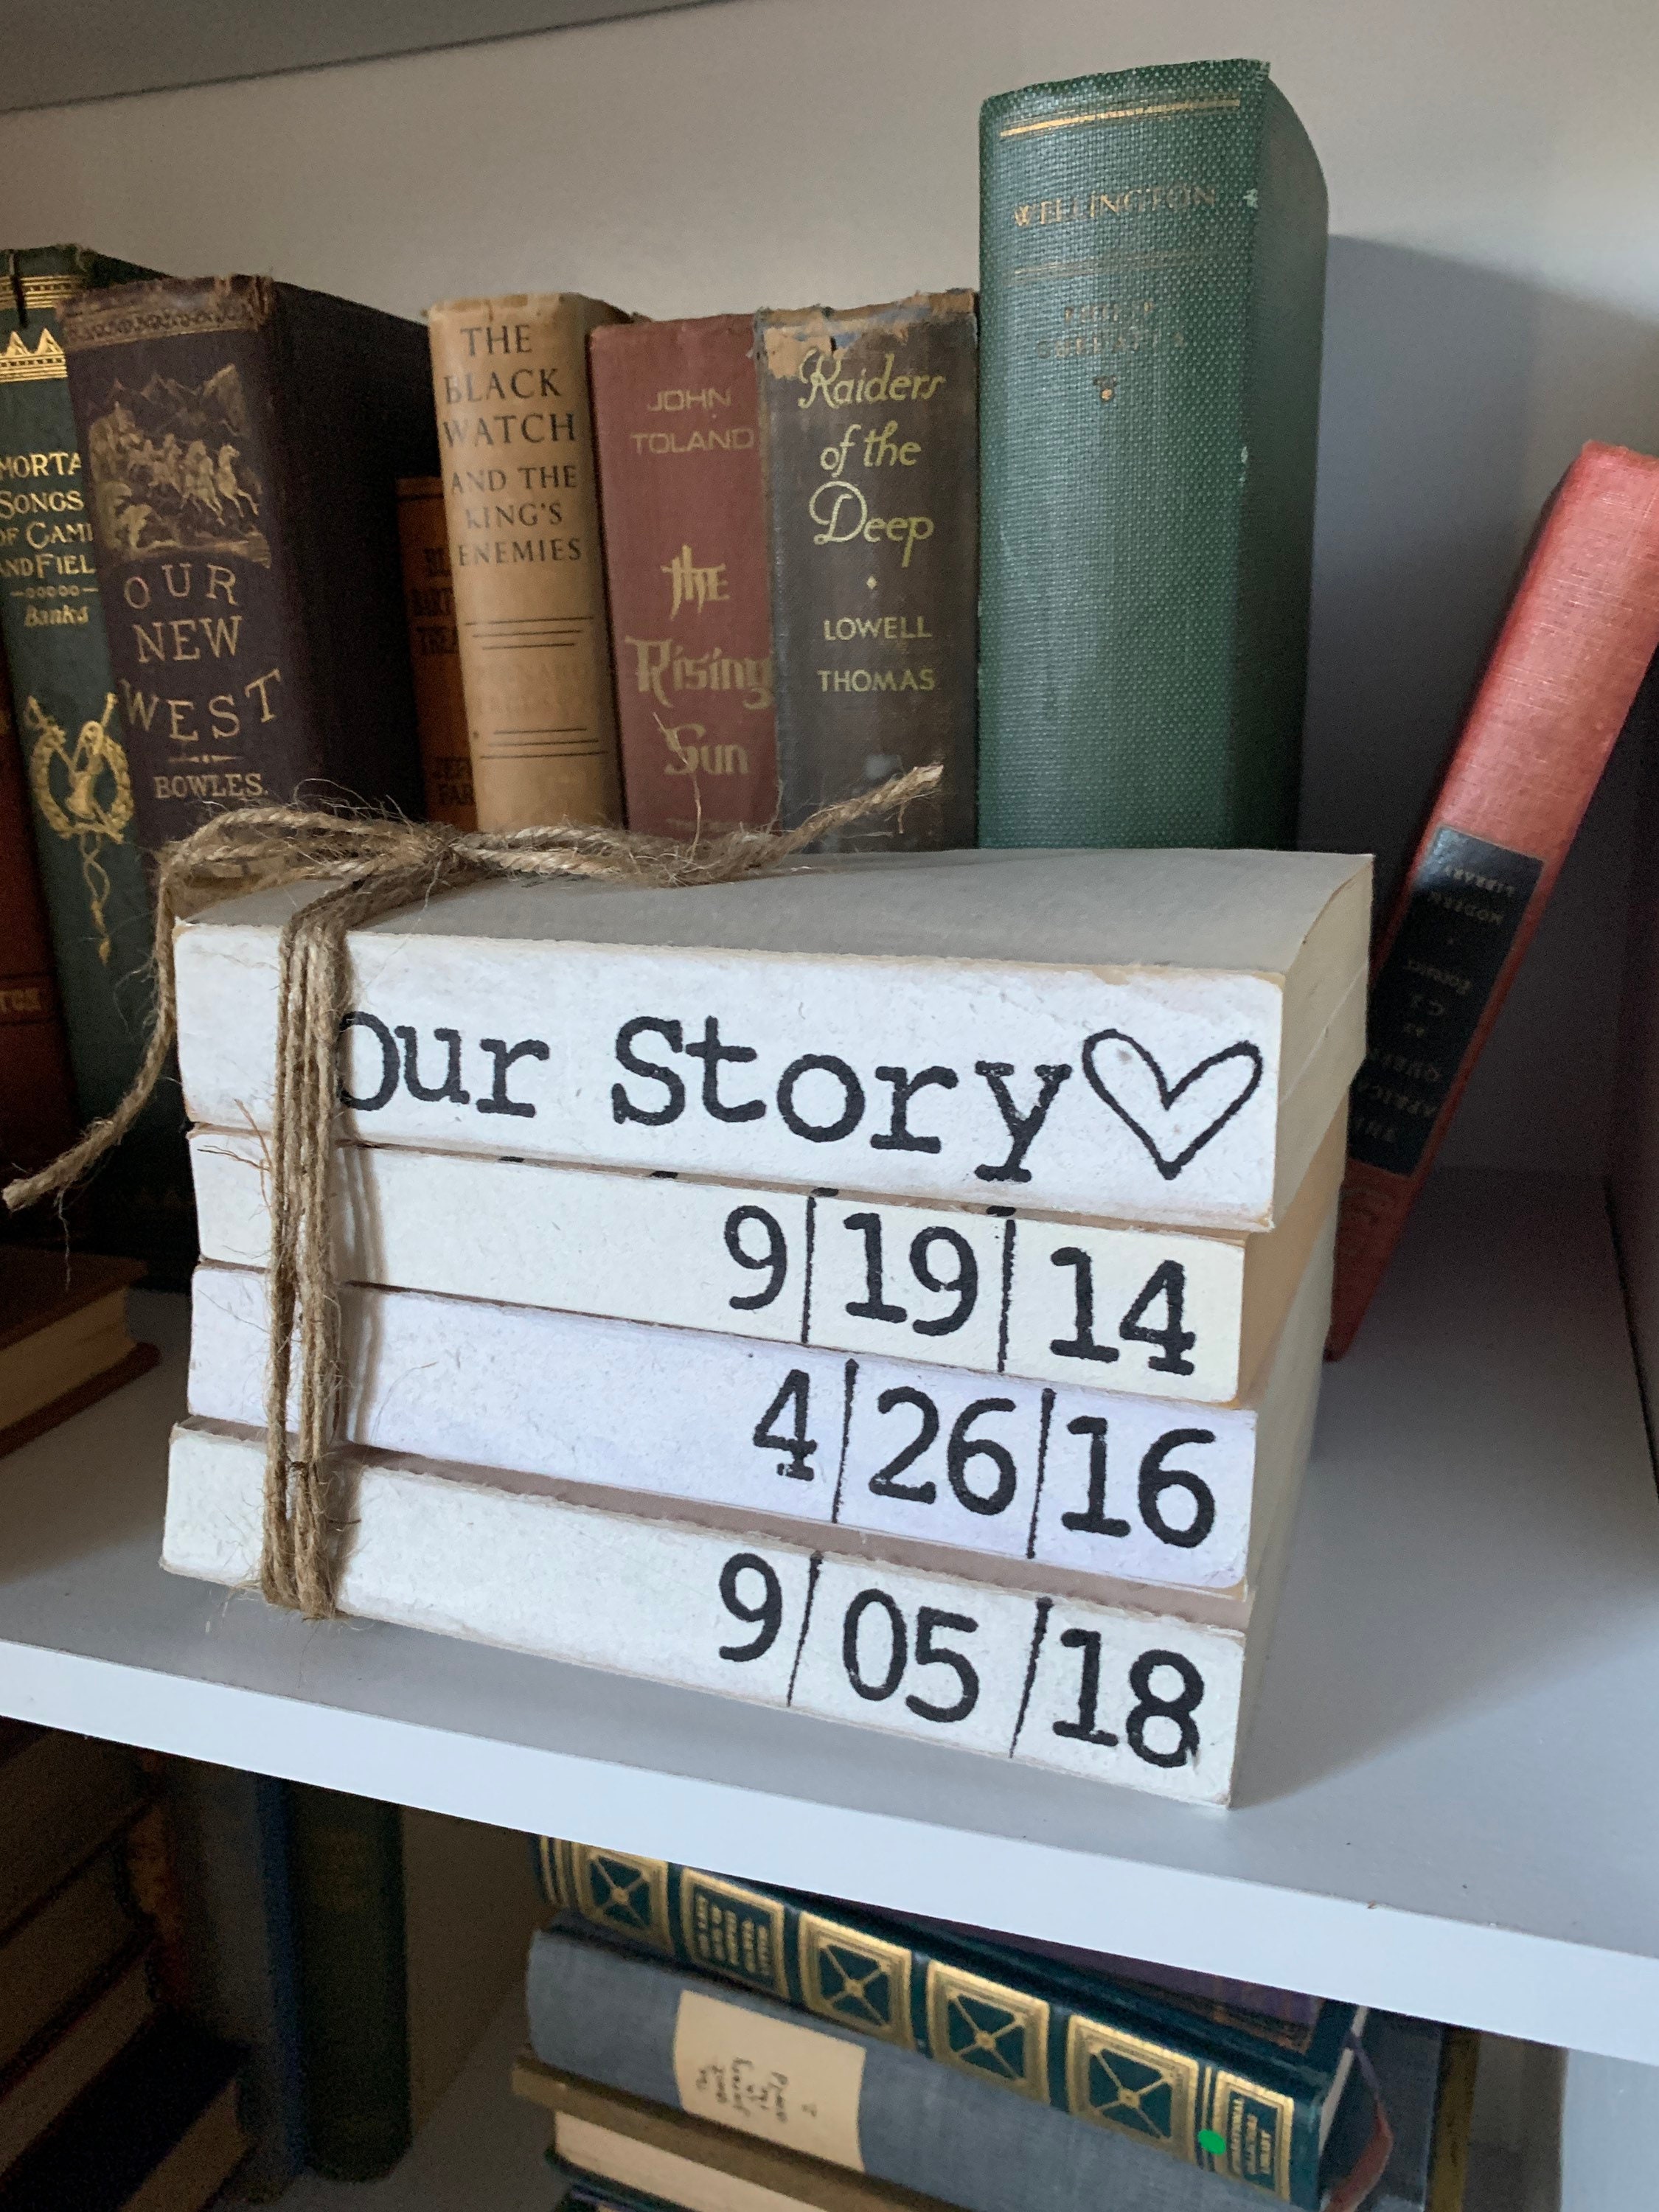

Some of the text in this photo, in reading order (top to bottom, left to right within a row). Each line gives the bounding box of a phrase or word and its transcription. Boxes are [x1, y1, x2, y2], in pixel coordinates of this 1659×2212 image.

[1013, 184, 1217, 227] WELLINGTON
[459, 324, 533, 358] THE
[443, 369, 562, 405] BLACK
[797, 348, 946, 410] Raiders
[647, 388, 731, 413] JOHN
[442, 413, 577, 448] WATCH
[630, 428, 755, 456] TOLAND
[820, 420, 922, 477] of the
[451, 465, 579, 493] AND THE
[0, 490, 85, 521] SONGS
[810, 481, 935, 568] Deep
[457, 538, 582, 568] ENEMIES
[124, 563, 238, 611] OUR
[132, 615, 243, 665] NEW
[824, 616, 933, 642] LOWELL
[624, 635, 775, 710] Rising
[817, 668, 936, 693] THOMAS
[119, 668, 283, 742] WEST
[662, 723, 751, 776] Sun
[334, 1010, 1071, 1181] Our Story
